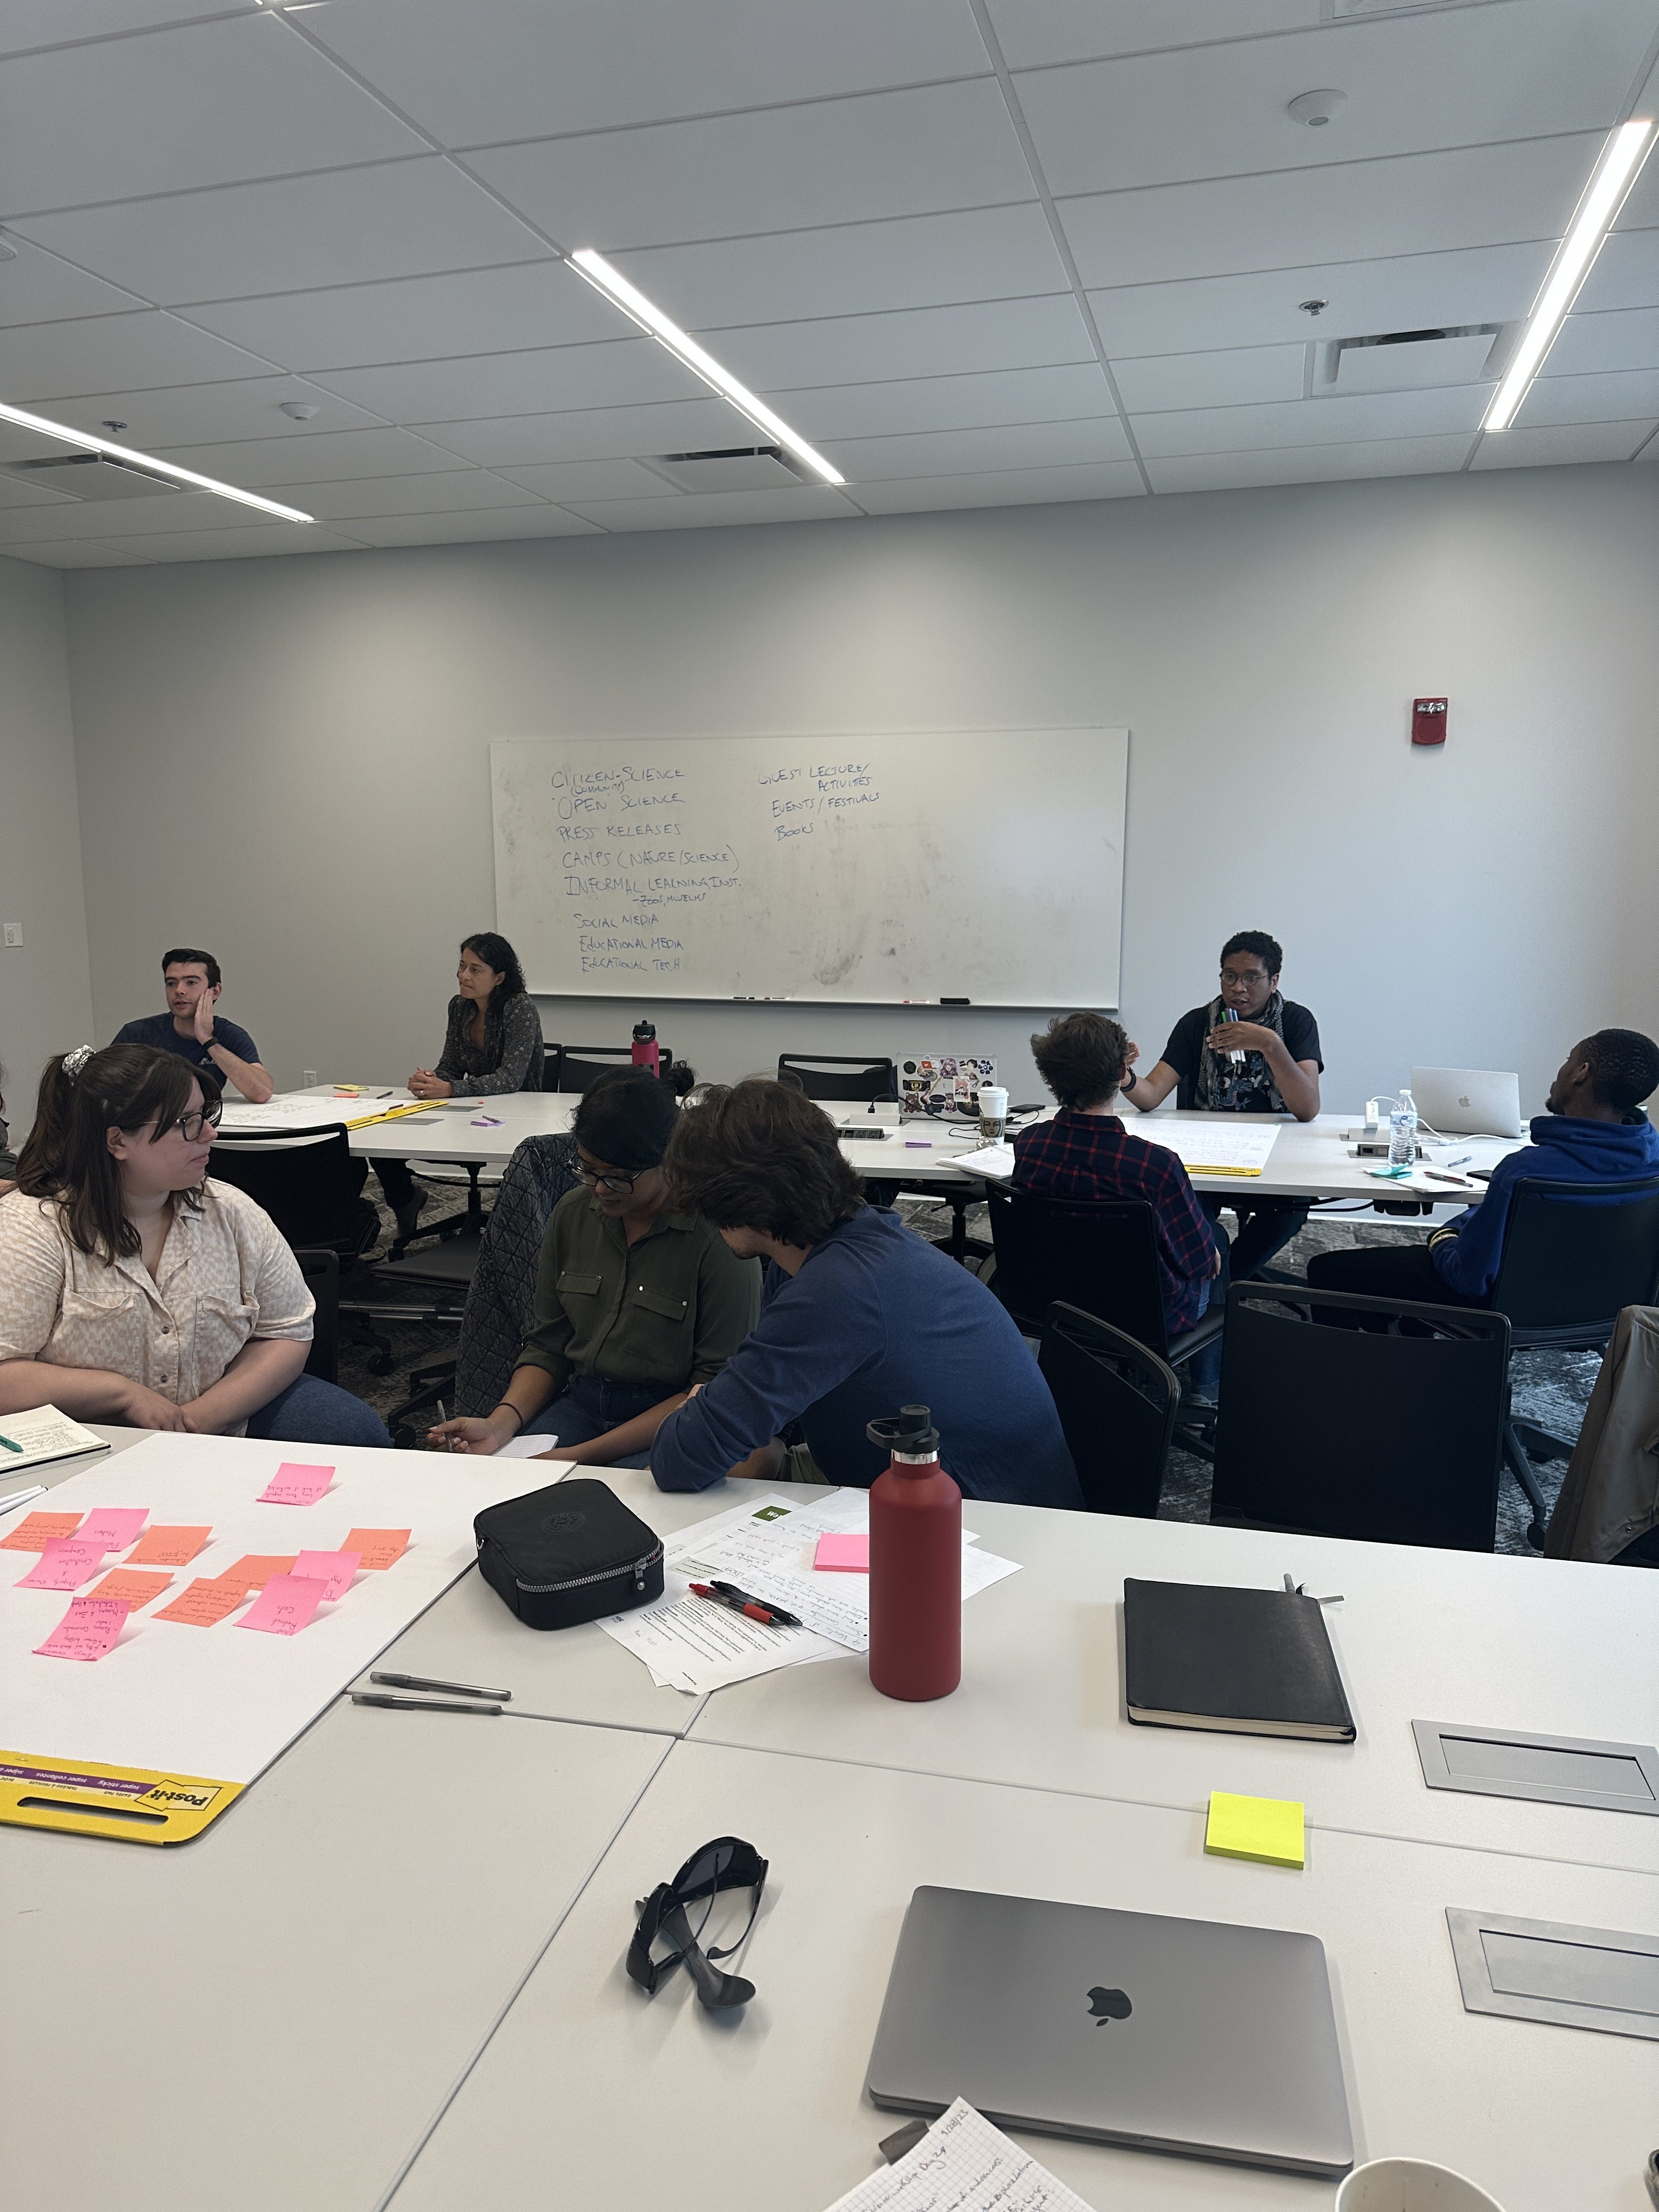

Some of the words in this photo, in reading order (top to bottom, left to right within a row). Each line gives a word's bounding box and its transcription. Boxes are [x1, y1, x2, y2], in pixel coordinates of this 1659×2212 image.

[758, 769, 802, 785] GUEST
[819, 776, 872, 792] ACTIVITIES
[558, 797, 607, 820] OPEN
[620, 793, 686, 811] SCIENCE
[556, 826, 599, 843] PRESS
[606, 824, 681, 837] RELEASES
[562, 851, 612, 868] CAMPS
[564, 876, 644, 896] INFORMAL
[648, 877, 710, 891] LEARNING
[708, 876, 742, 888] INST.
[667, 893, 707, 902] MUSEUMS
[573, 913, 618, 929] SOCIAL
[622, 913, 659, 927] MEDIA
[651, 937, 684, 951] MEDIA
[652, 957, 681, 971] TECH
[36, 1772, 67, 1782] collantes
[148, 1789, 210, 1807] Post-it
